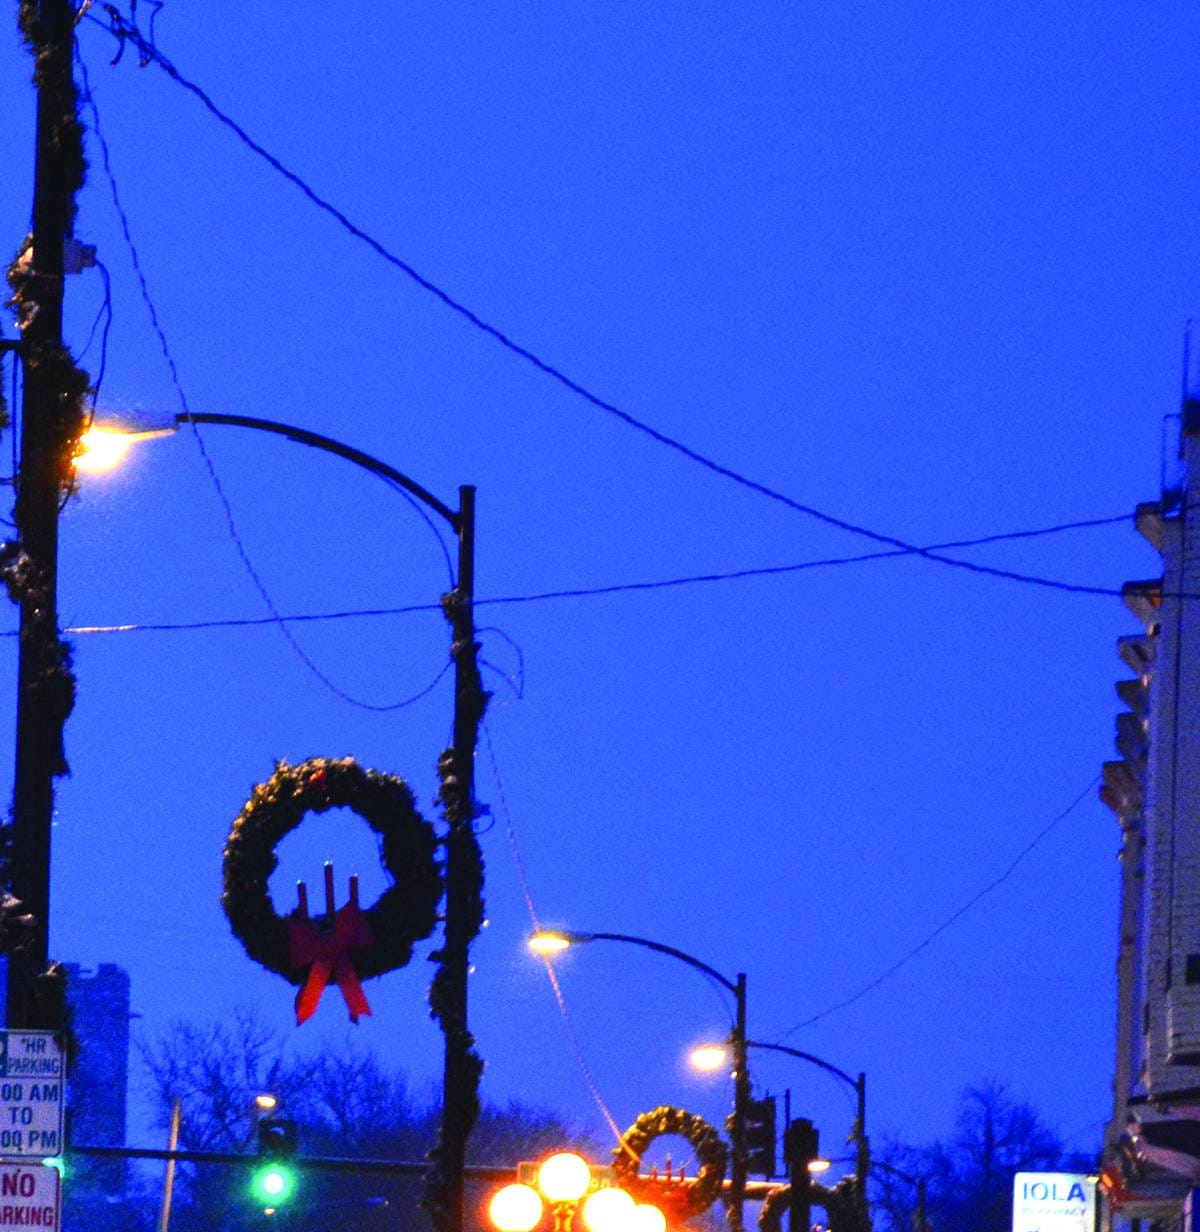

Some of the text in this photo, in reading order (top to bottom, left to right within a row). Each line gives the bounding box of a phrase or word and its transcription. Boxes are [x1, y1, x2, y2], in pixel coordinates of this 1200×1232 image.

[25, 1038, 46, 1053] HR
[8, 1057, 59, 1074] PARKING
[29, 1084, 58, 1101] AM
[8, 1106, 33, 1125] TO
[28, 1130, 57, 1147] PM
[2, 1173, 36, 1197] NO
[1023, 1182, 1087, 1202] IOLA
